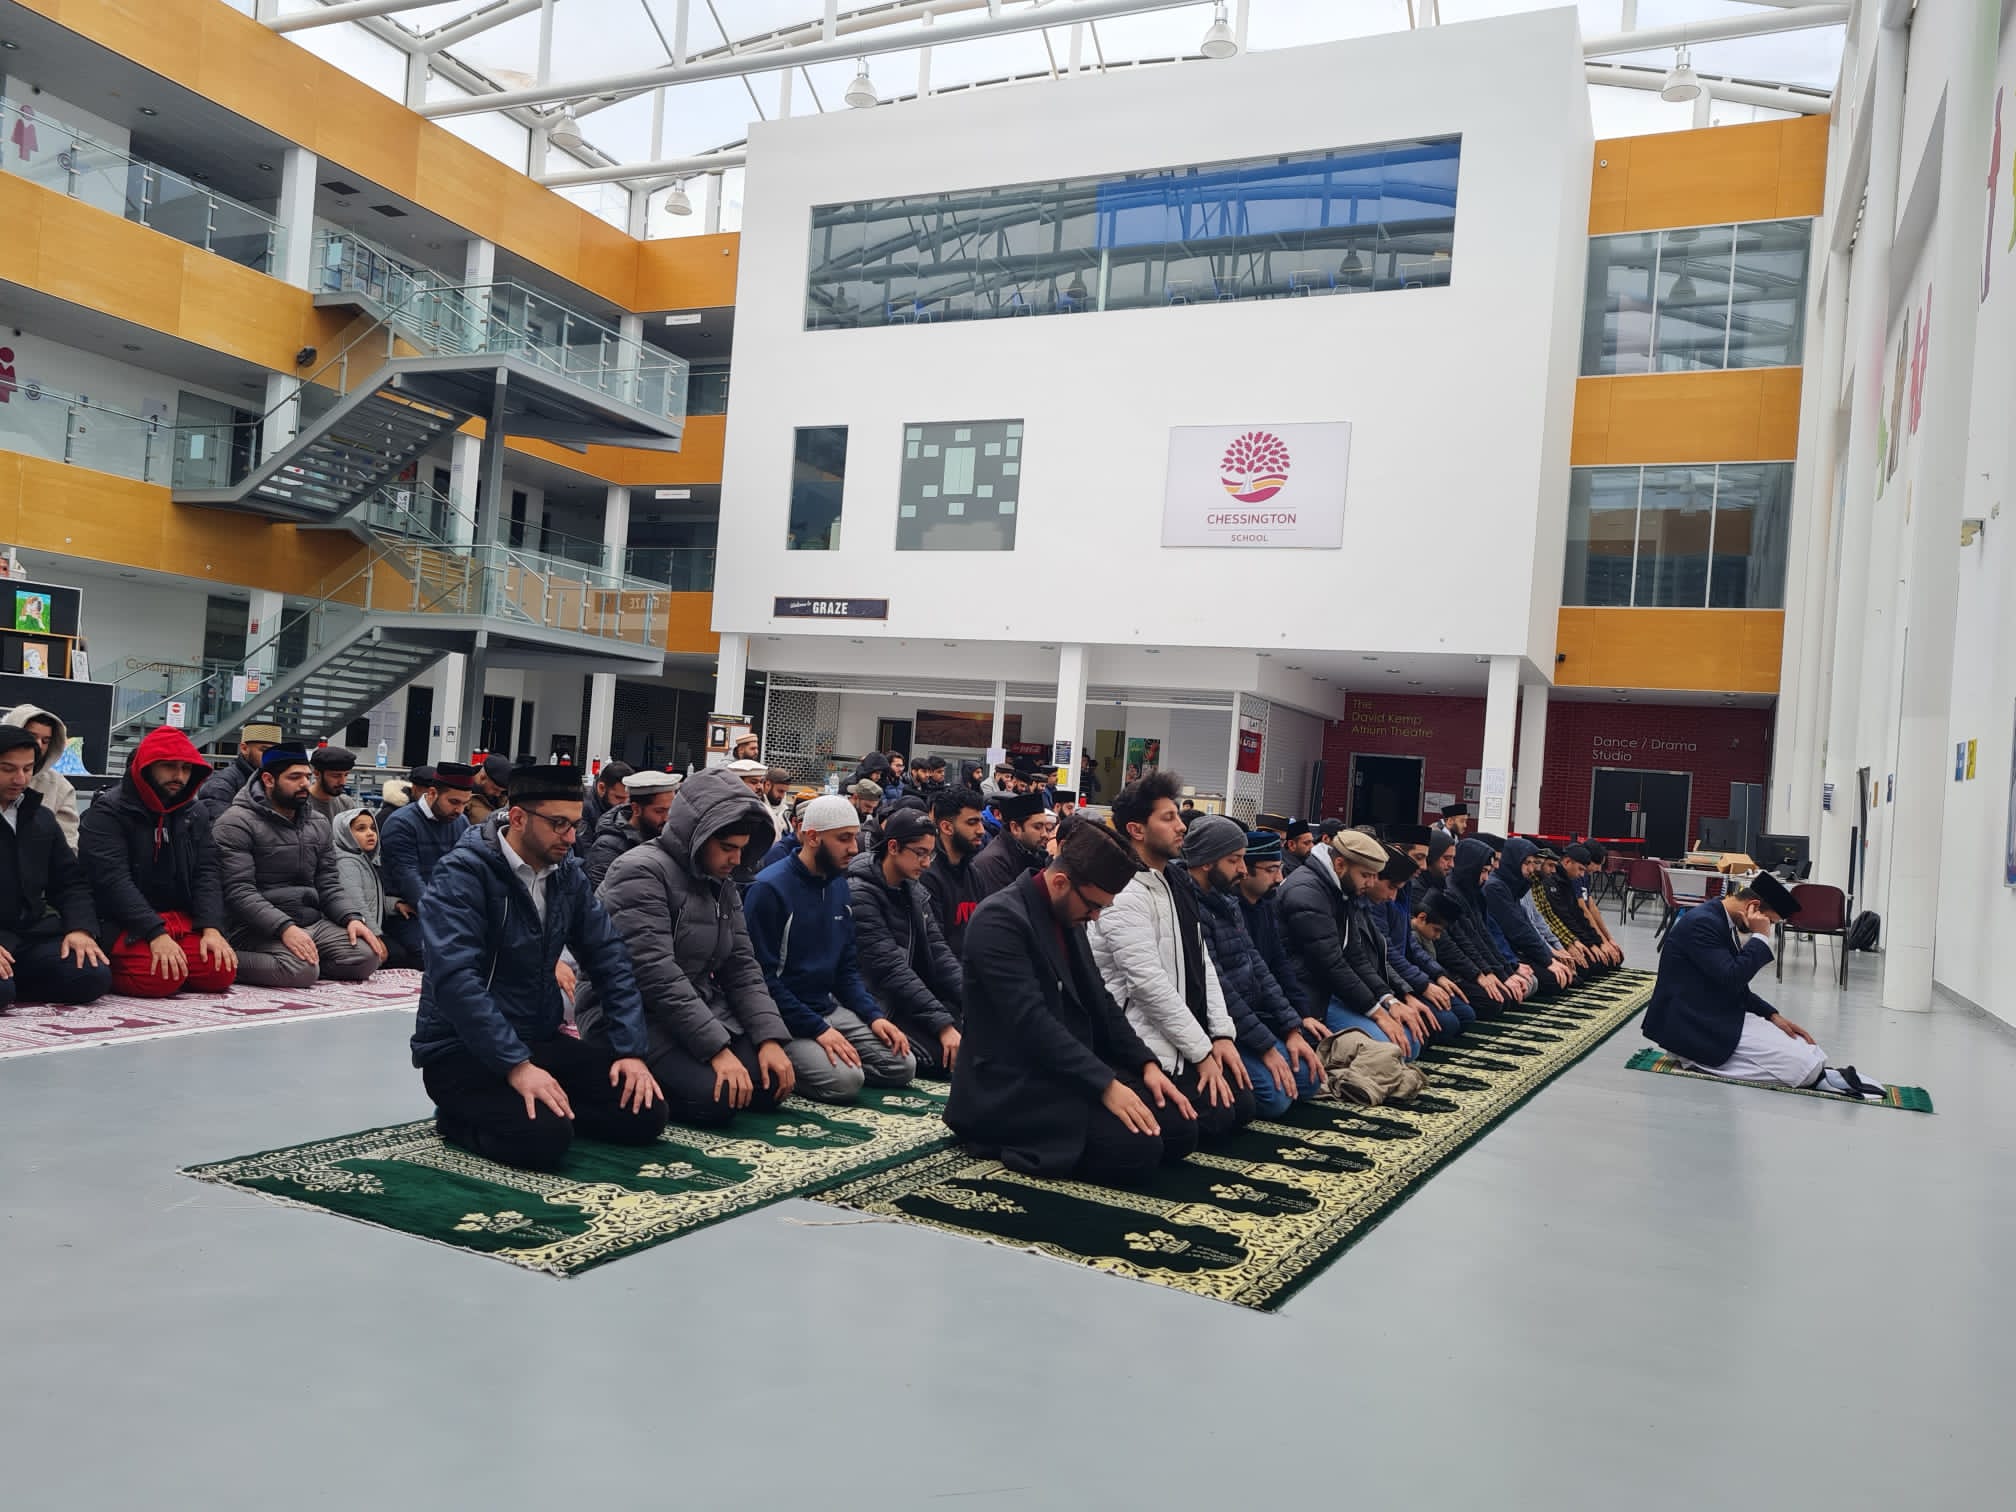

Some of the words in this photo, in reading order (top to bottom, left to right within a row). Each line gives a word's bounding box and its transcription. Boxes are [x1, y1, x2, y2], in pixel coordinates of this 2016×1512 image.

[1207, 513, 1297, 525] CHESSINGTON
[1231, 534, 1269, 542] SCHOOL
[812, 601, 849, 615] GRAZE
[1352, 711, 1385, 721] David
[1388, 714, 1424, 725] Kemp
[1352, 725, 1386, 735] Atrium
[1593, 736, 1638, 748] Dance
[1651, 739, 1697, 752] Drama
[1592, 750, 1632, 761] Studio
